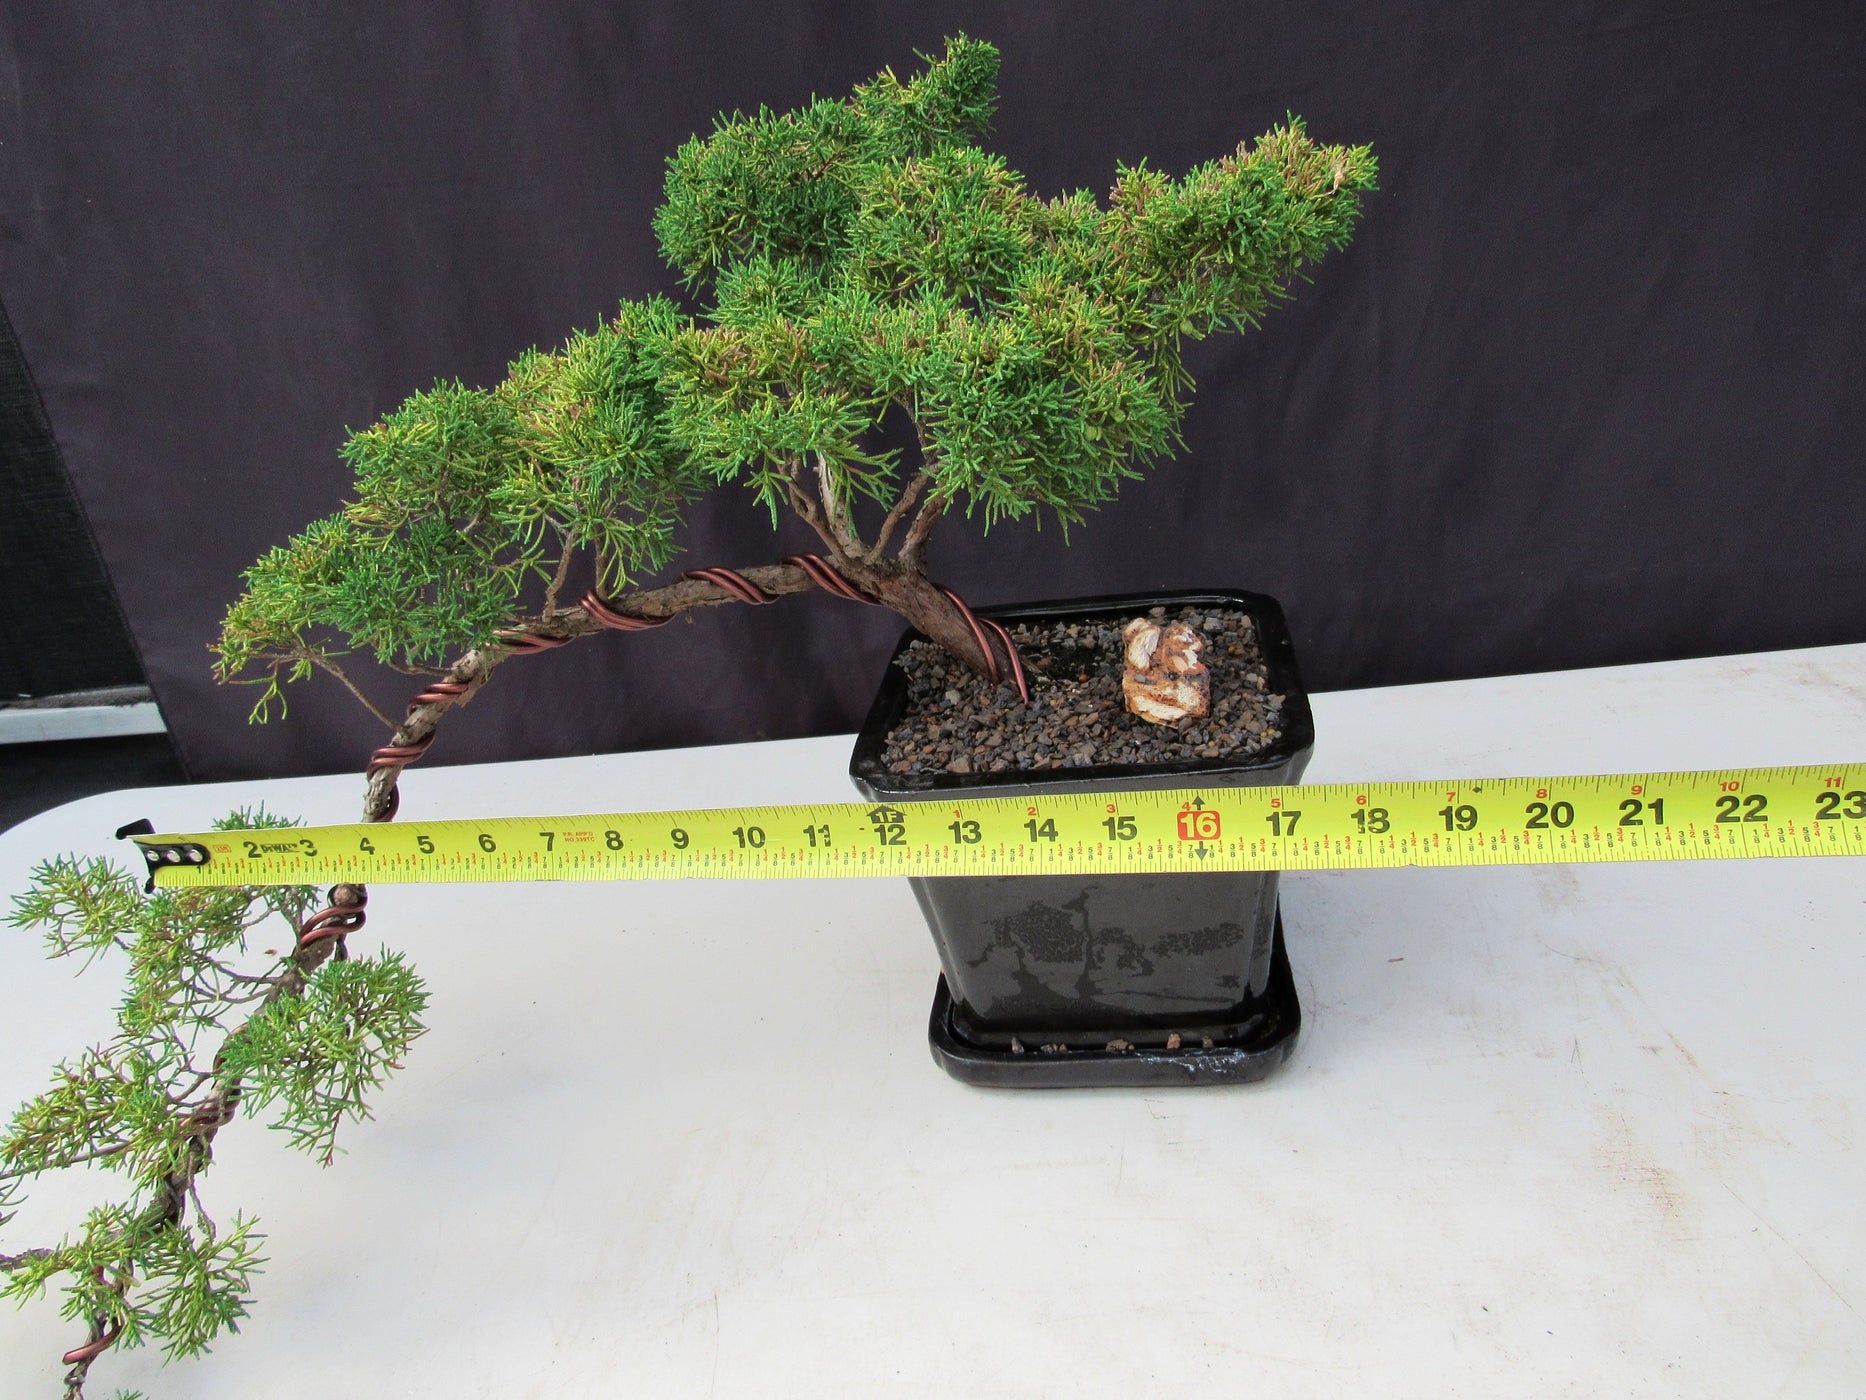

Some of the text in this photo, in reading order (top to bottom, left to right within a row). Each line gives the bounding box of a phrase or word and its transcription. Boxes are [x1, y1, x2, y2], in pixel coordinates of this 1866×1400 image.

[1631, 785, 1642, 795] 9
[1720, 781, 1739, 791] 10
[1825, 777, 1841, 787] 11
[1357, 796, 1366, 805] 6
[1447, 792, 1456, 802] 7
[1536, 789, 1547, 798] 8
[1028, 808, 1036, 816] 2
[1107, 804, 1115, 813] 3
[1182, 802, 1190, 810] 4
[1271, 799, 1281, 808] 5
[1619, 798, 1664, 825] 21
[1716, 795, 1768, 822] 22
[1816, 791, 1866, 819] 23
[876, 812, 896, 822] 1F
[954, 810, 960, 818] 1
[1351, 808, 1390, 834] 18
[1439, 805, 1478, 831] 19
[1526, 802, 1574, 828] 20
[949, 821, 981, 844] 13
[1024, 818, 1058, 842] 14
[1102, 816, 1137, 840] 15
[1180, 814, 1217, 838] 16
[1266, 811, 1302, 836] 17
[479, 834, 496, 852] 6
[539, 832, 555, 851] 7
[605, 830, 623, 850] 8
[671, 829, 689, 849] 9
[733, 826, 765, 848] 10
[874, 824, 906, 845] 12
[244, 841, 262, 858] 2
[300, 840, 317, 856] 3
[361, 838, 374, 854] 4
[418, 836, 434, 854] 5
